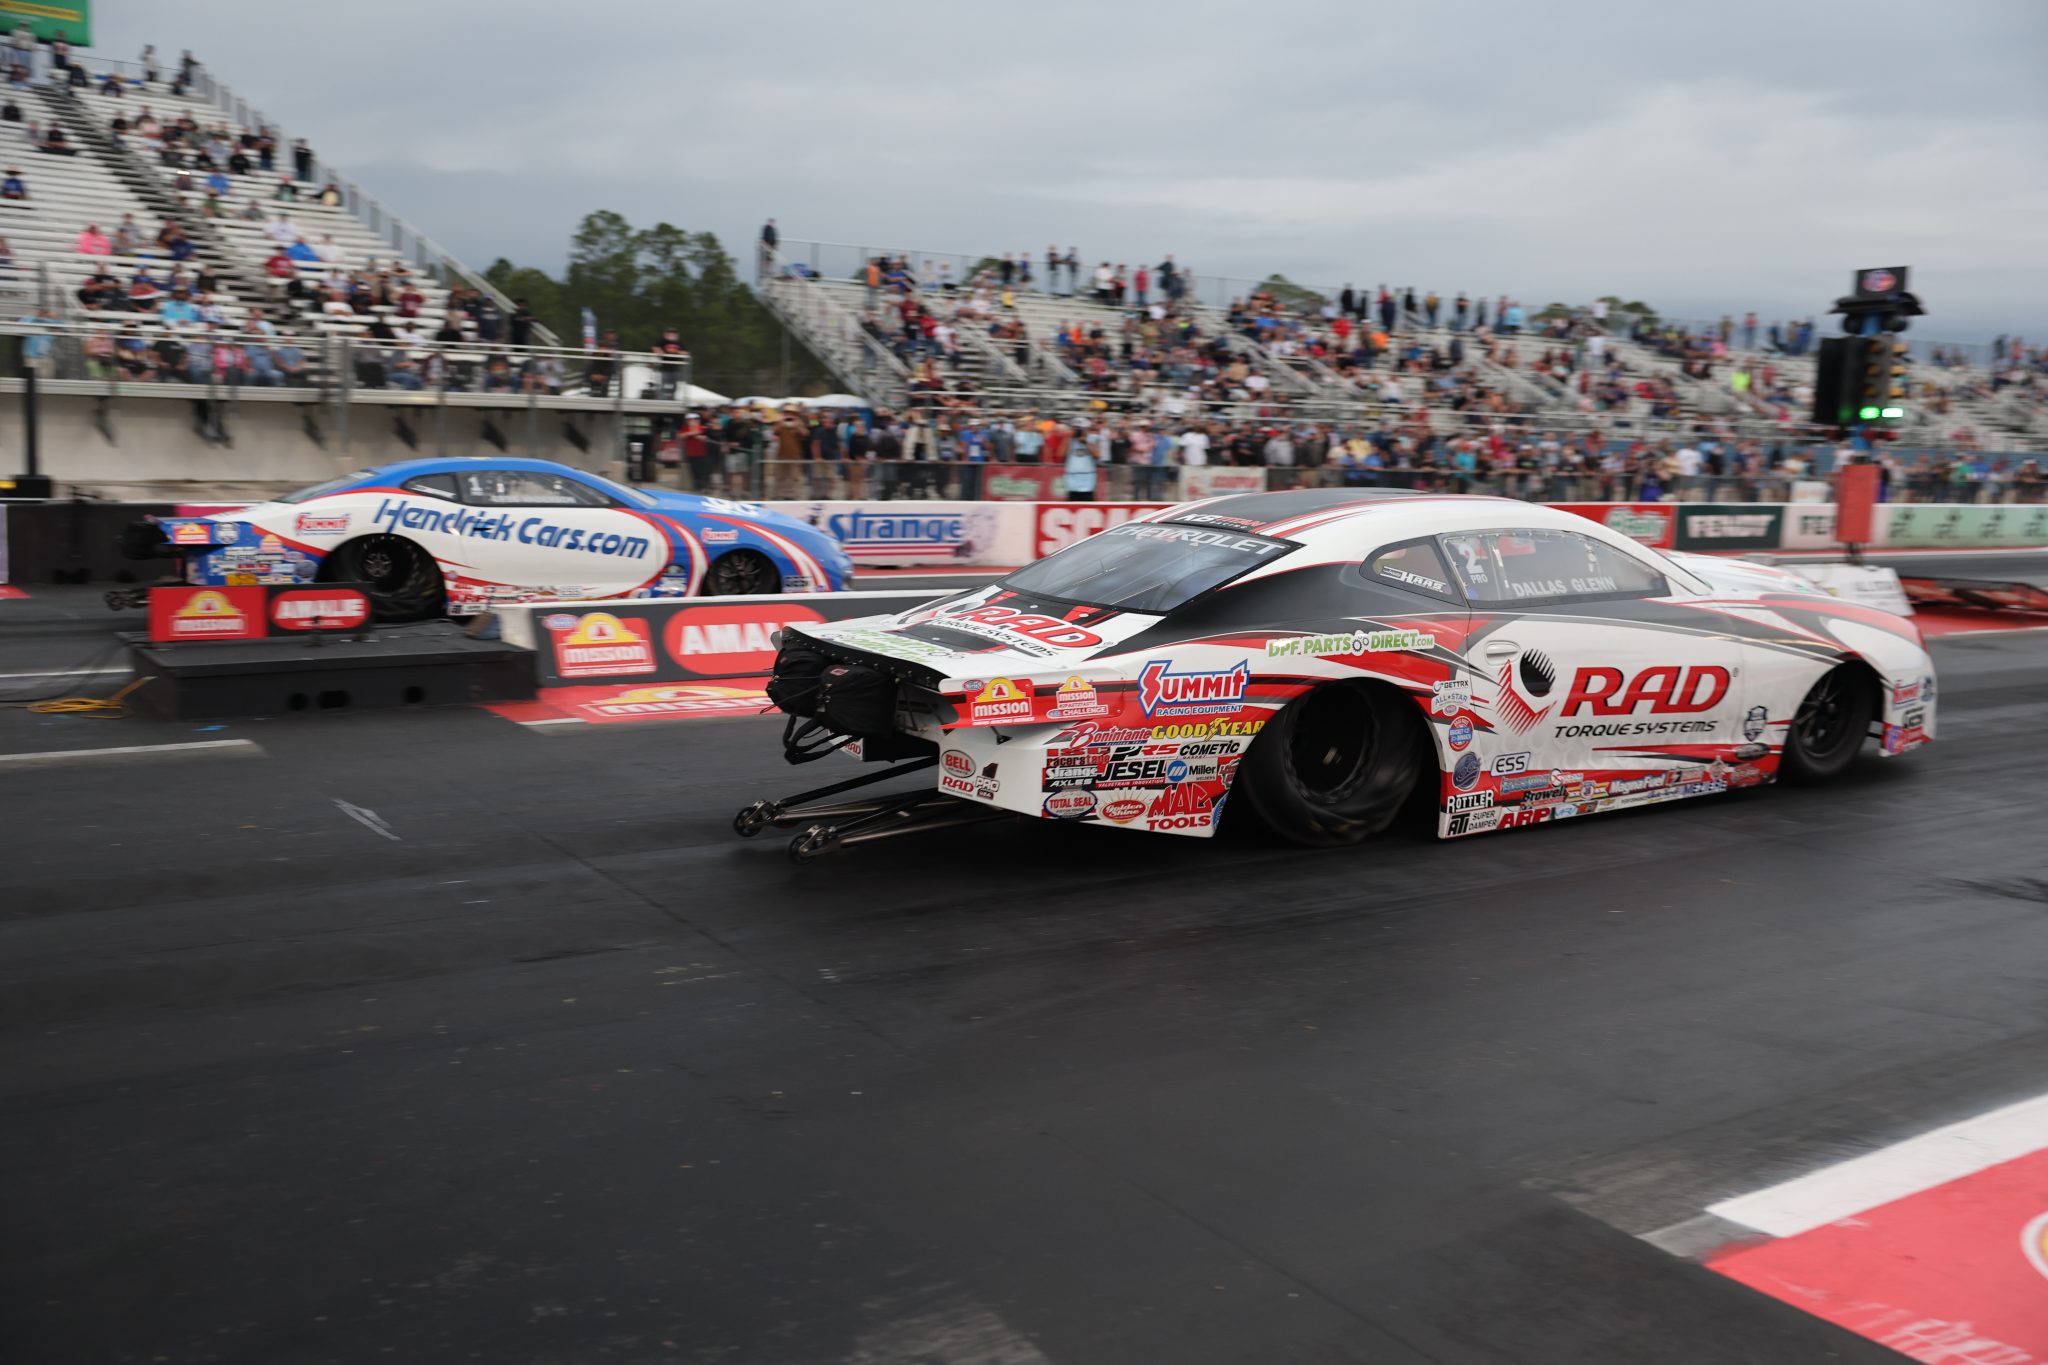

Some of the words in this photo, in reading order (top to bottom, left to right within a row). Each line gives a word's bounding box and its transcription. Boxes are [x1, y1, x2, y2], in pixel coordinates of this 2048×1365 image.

[1457, 543, 1485, 574] 2
[1469, 574, 1488, 584] PRO
[1511, 577, 1567, 597] DALLAS
[1573, 575, 1618, 593] GLENN
[948, 607, 1103, 648] RAD
[1304, 636, 1350, 654] PARTS
[1560, 666, 1731, 717] RAD
[1063, 706, 1107, 716] CHALLENGE
[1157, 708, 1190, 716] RACING
[1192, 705, 1243, 715] EQUIPMENT
[1554, 724, 1632, 739] TORQUE
[1633, 720, 1718, 735] SYSTEMS
[1180, 740, 1240, 756] COMETIC
[945, 753, 972, 772] BELL
[1096, 760, 1166, 782] JESEL
[1189, 765, 1216, 776] Miller
[1496, 754, 1526, 773] ESS
[943, 776, 974, 792] RAD
[1050, 778, 1093, 787] AXLES
[1049, 798, 1072, 809] TOTAL
[1073, 796, 1093, 807] SEAL
[1147, 783, 1213, 818] MAC
[1447, 789, 1495, 814] ROTTLER
[1146, 816, 1211, 831] TOOLS
[1473, 810, 1495, 821] SUPER
[1497, 807, 1551, 830] ARP
[1469, 819, 1497, 831] DAMPER
